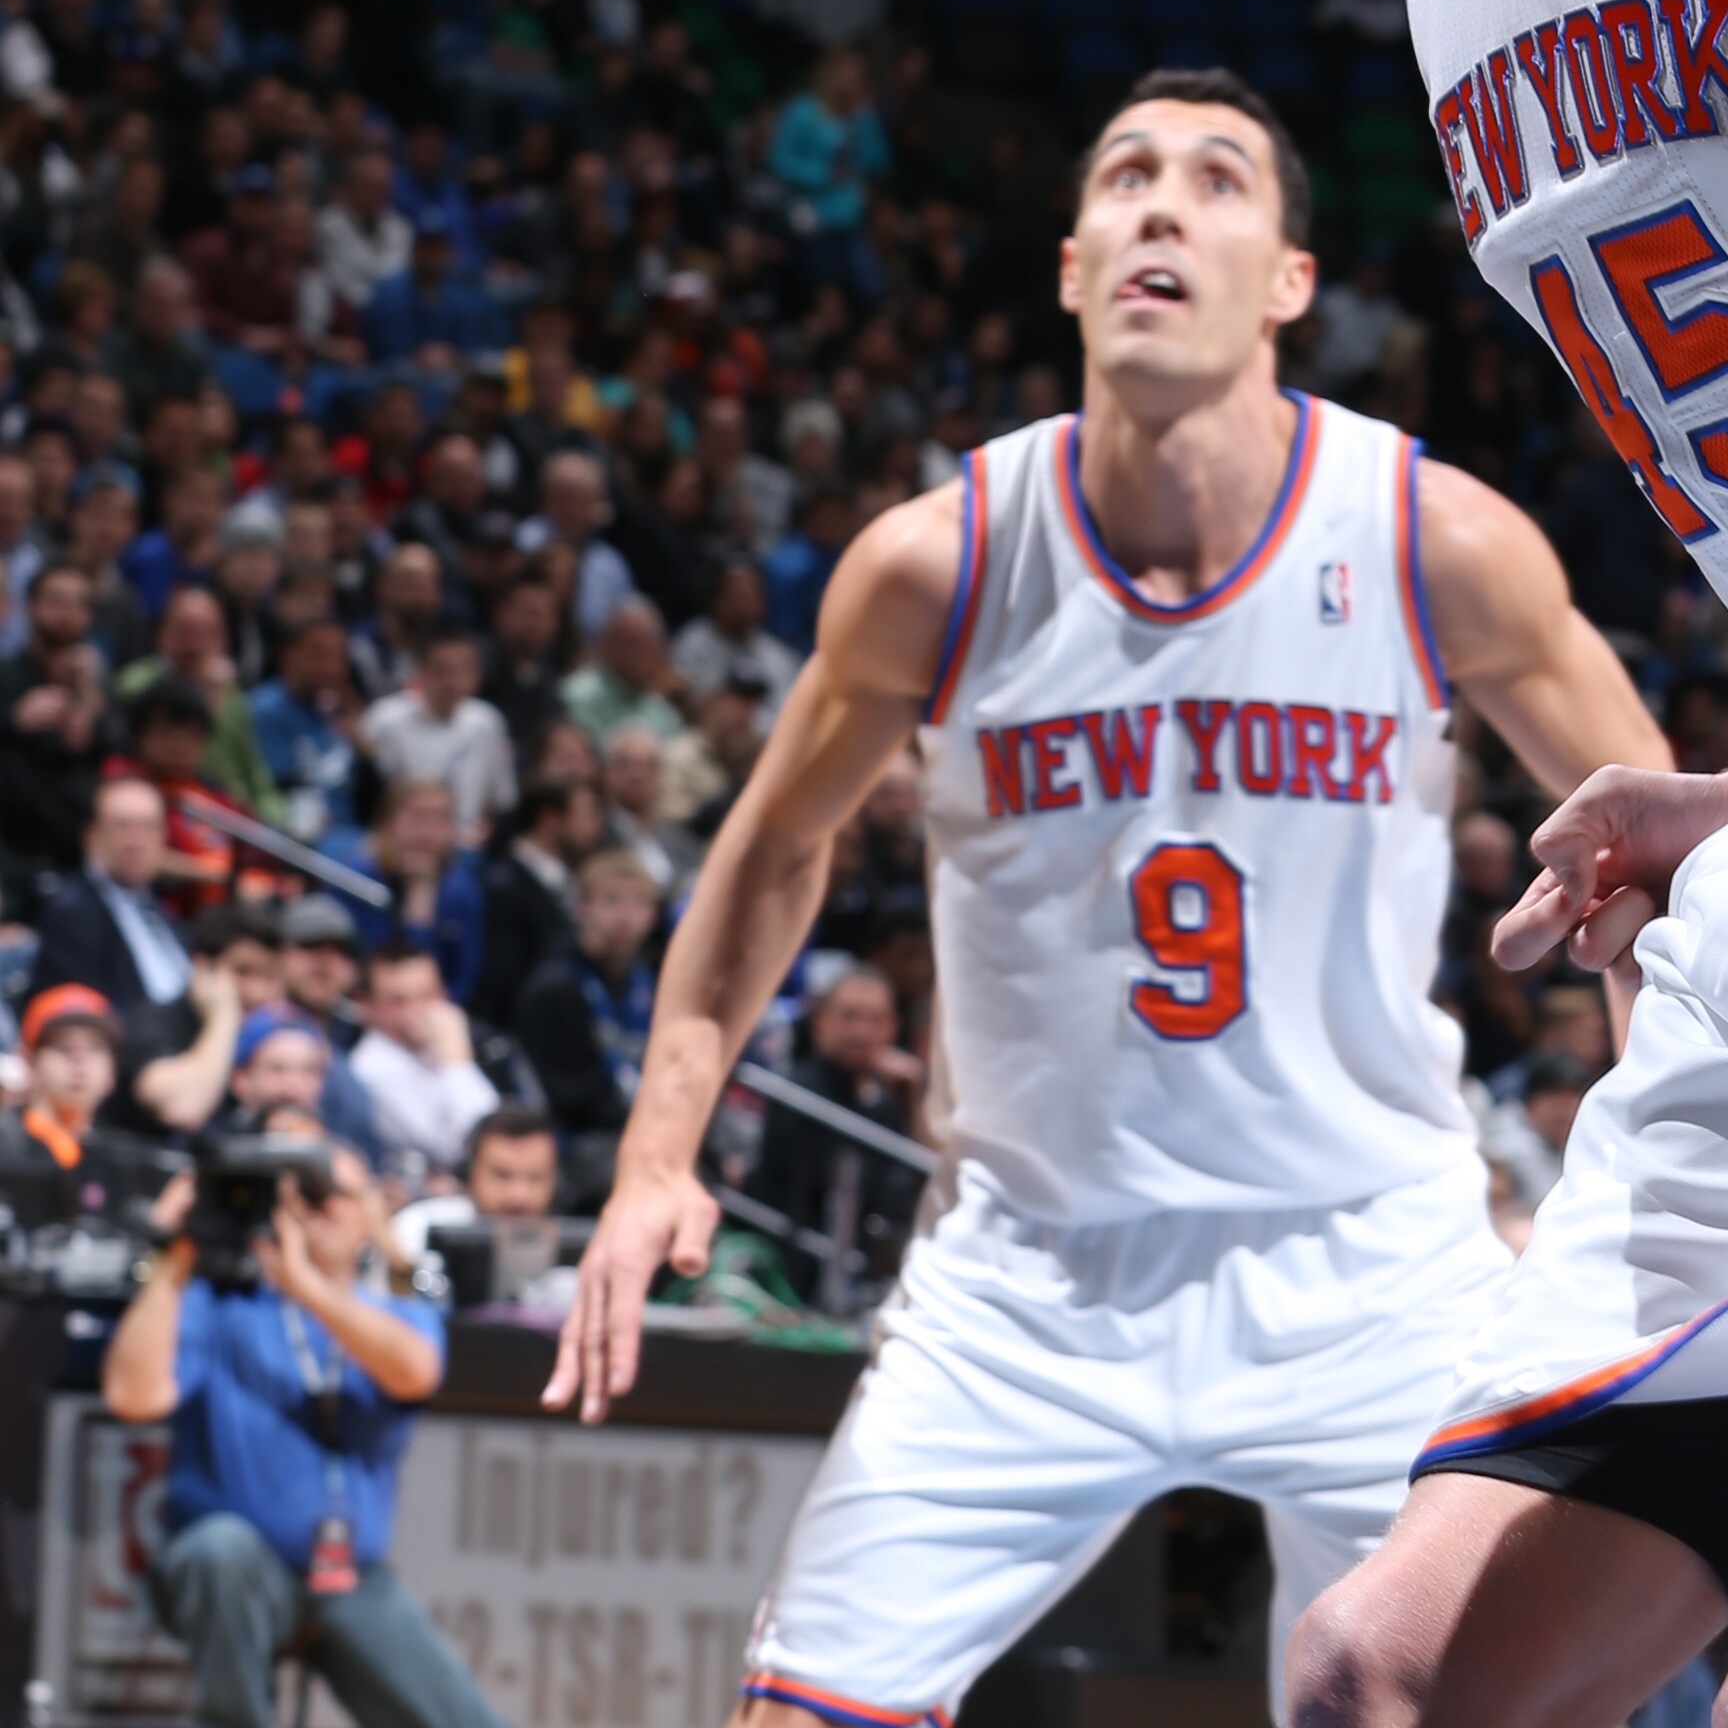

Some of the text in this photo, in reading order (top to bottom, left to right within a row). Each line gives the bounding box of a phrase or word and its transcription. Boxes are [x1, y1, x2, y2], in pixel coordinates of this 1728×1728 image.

[1436, 54, 1530, 250] EW
[976, 697, 1398, 818] NEW YORK
[1128, 839, 1248, 1042] 9
[456, 1424, 762, 1567] Injured?
